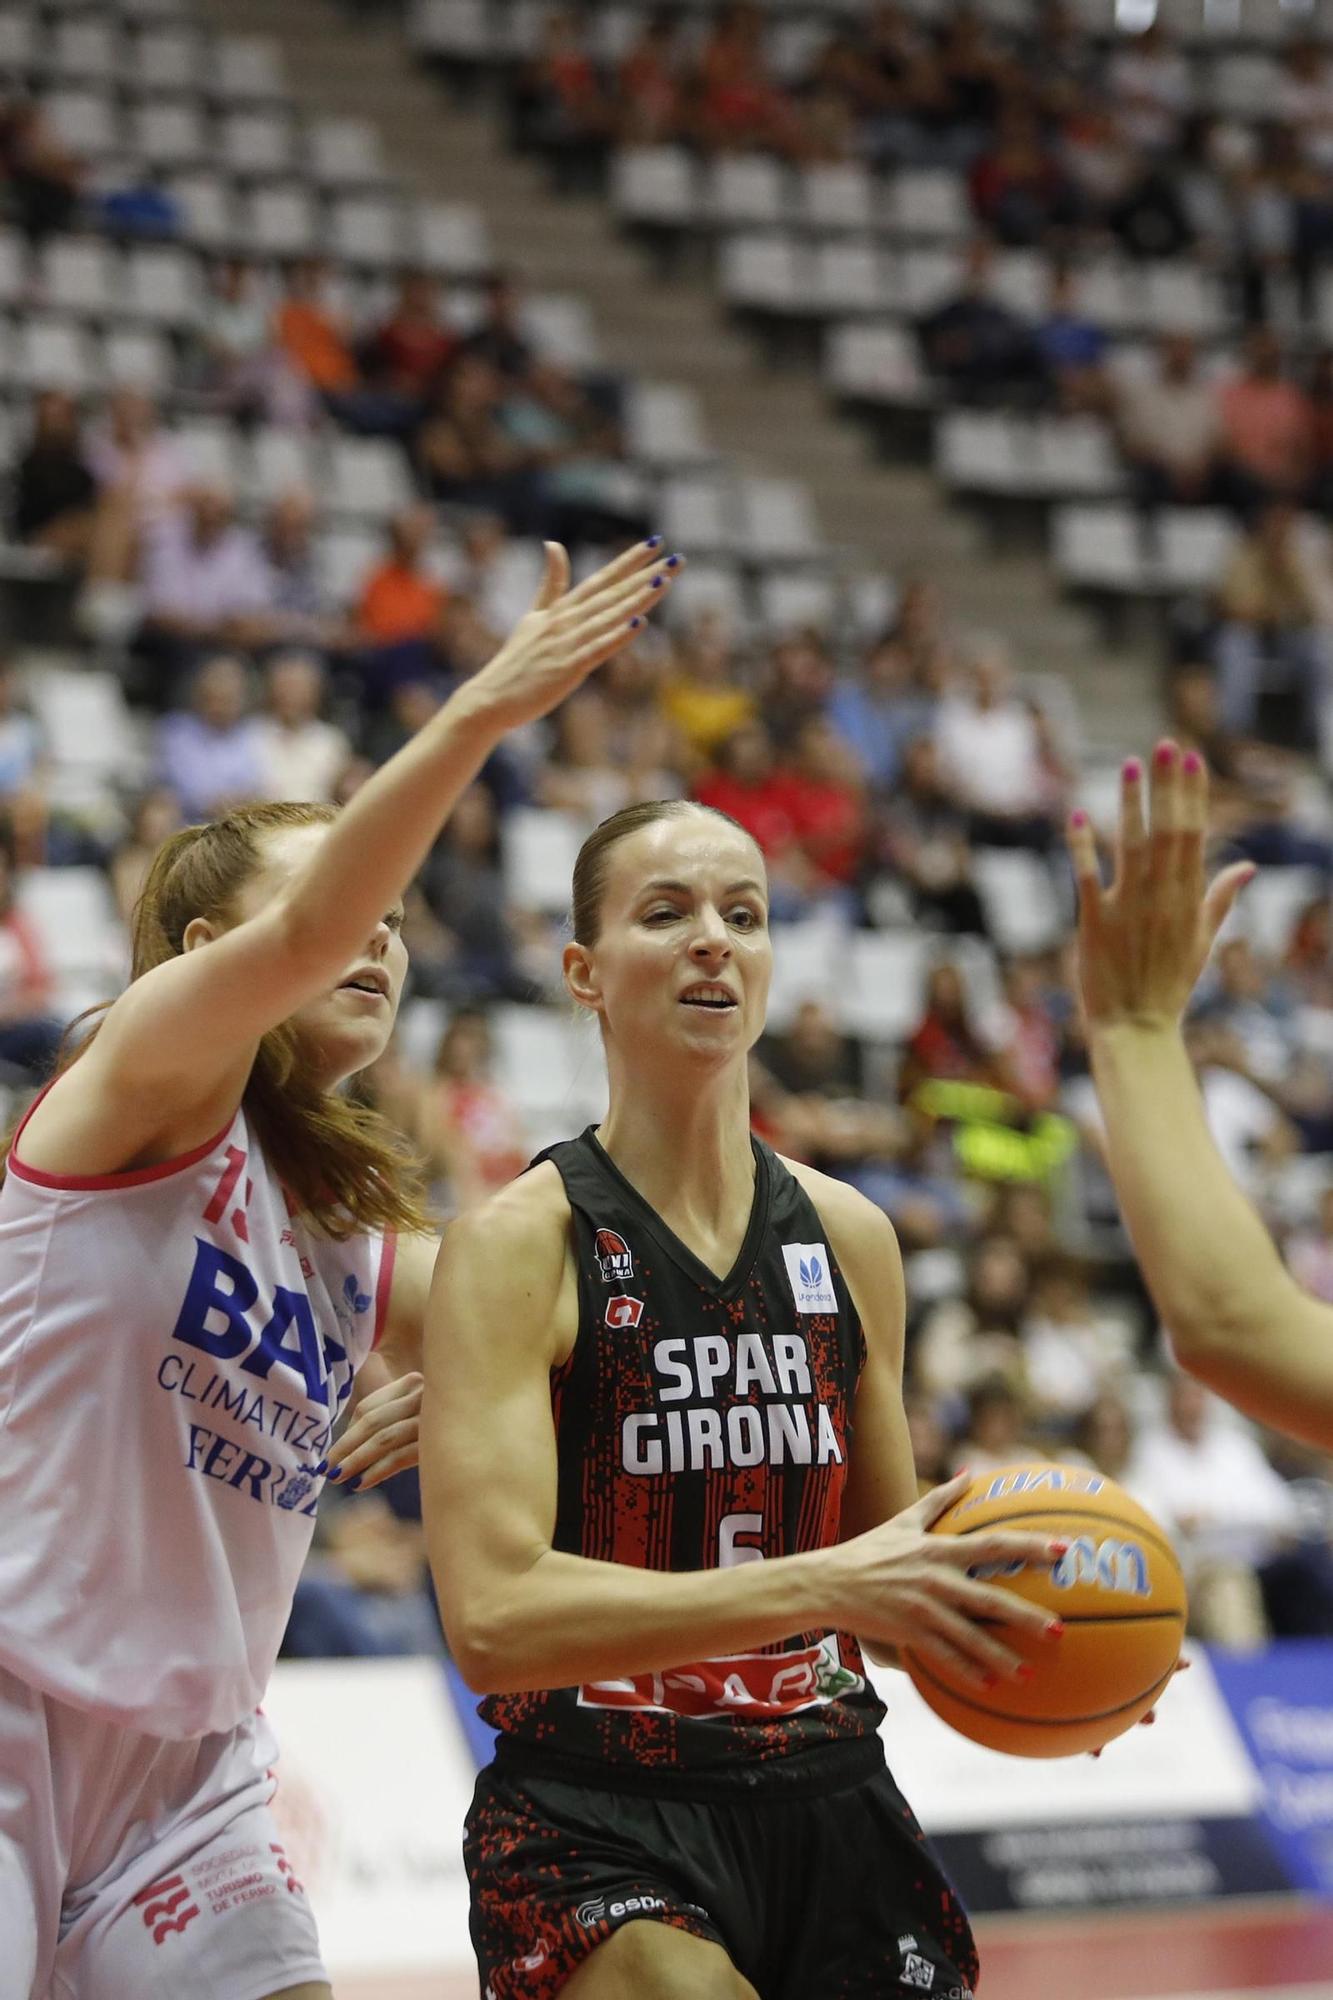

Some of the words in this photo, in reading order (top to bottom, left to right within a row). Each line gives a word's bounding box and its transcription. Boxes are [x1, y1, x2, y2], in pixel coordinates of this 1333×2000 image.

[653, 1333, 812, 1401] SPAR
[156, 1354, 334, 1457] CLIMATIZA
[622, 1404, 843, 1475] GIRONA
[206, 1871, 263, 1900] TURISMO
[212, 1899, 230, 1914] DE
[233, 1883, 276, 1904] FERRO
